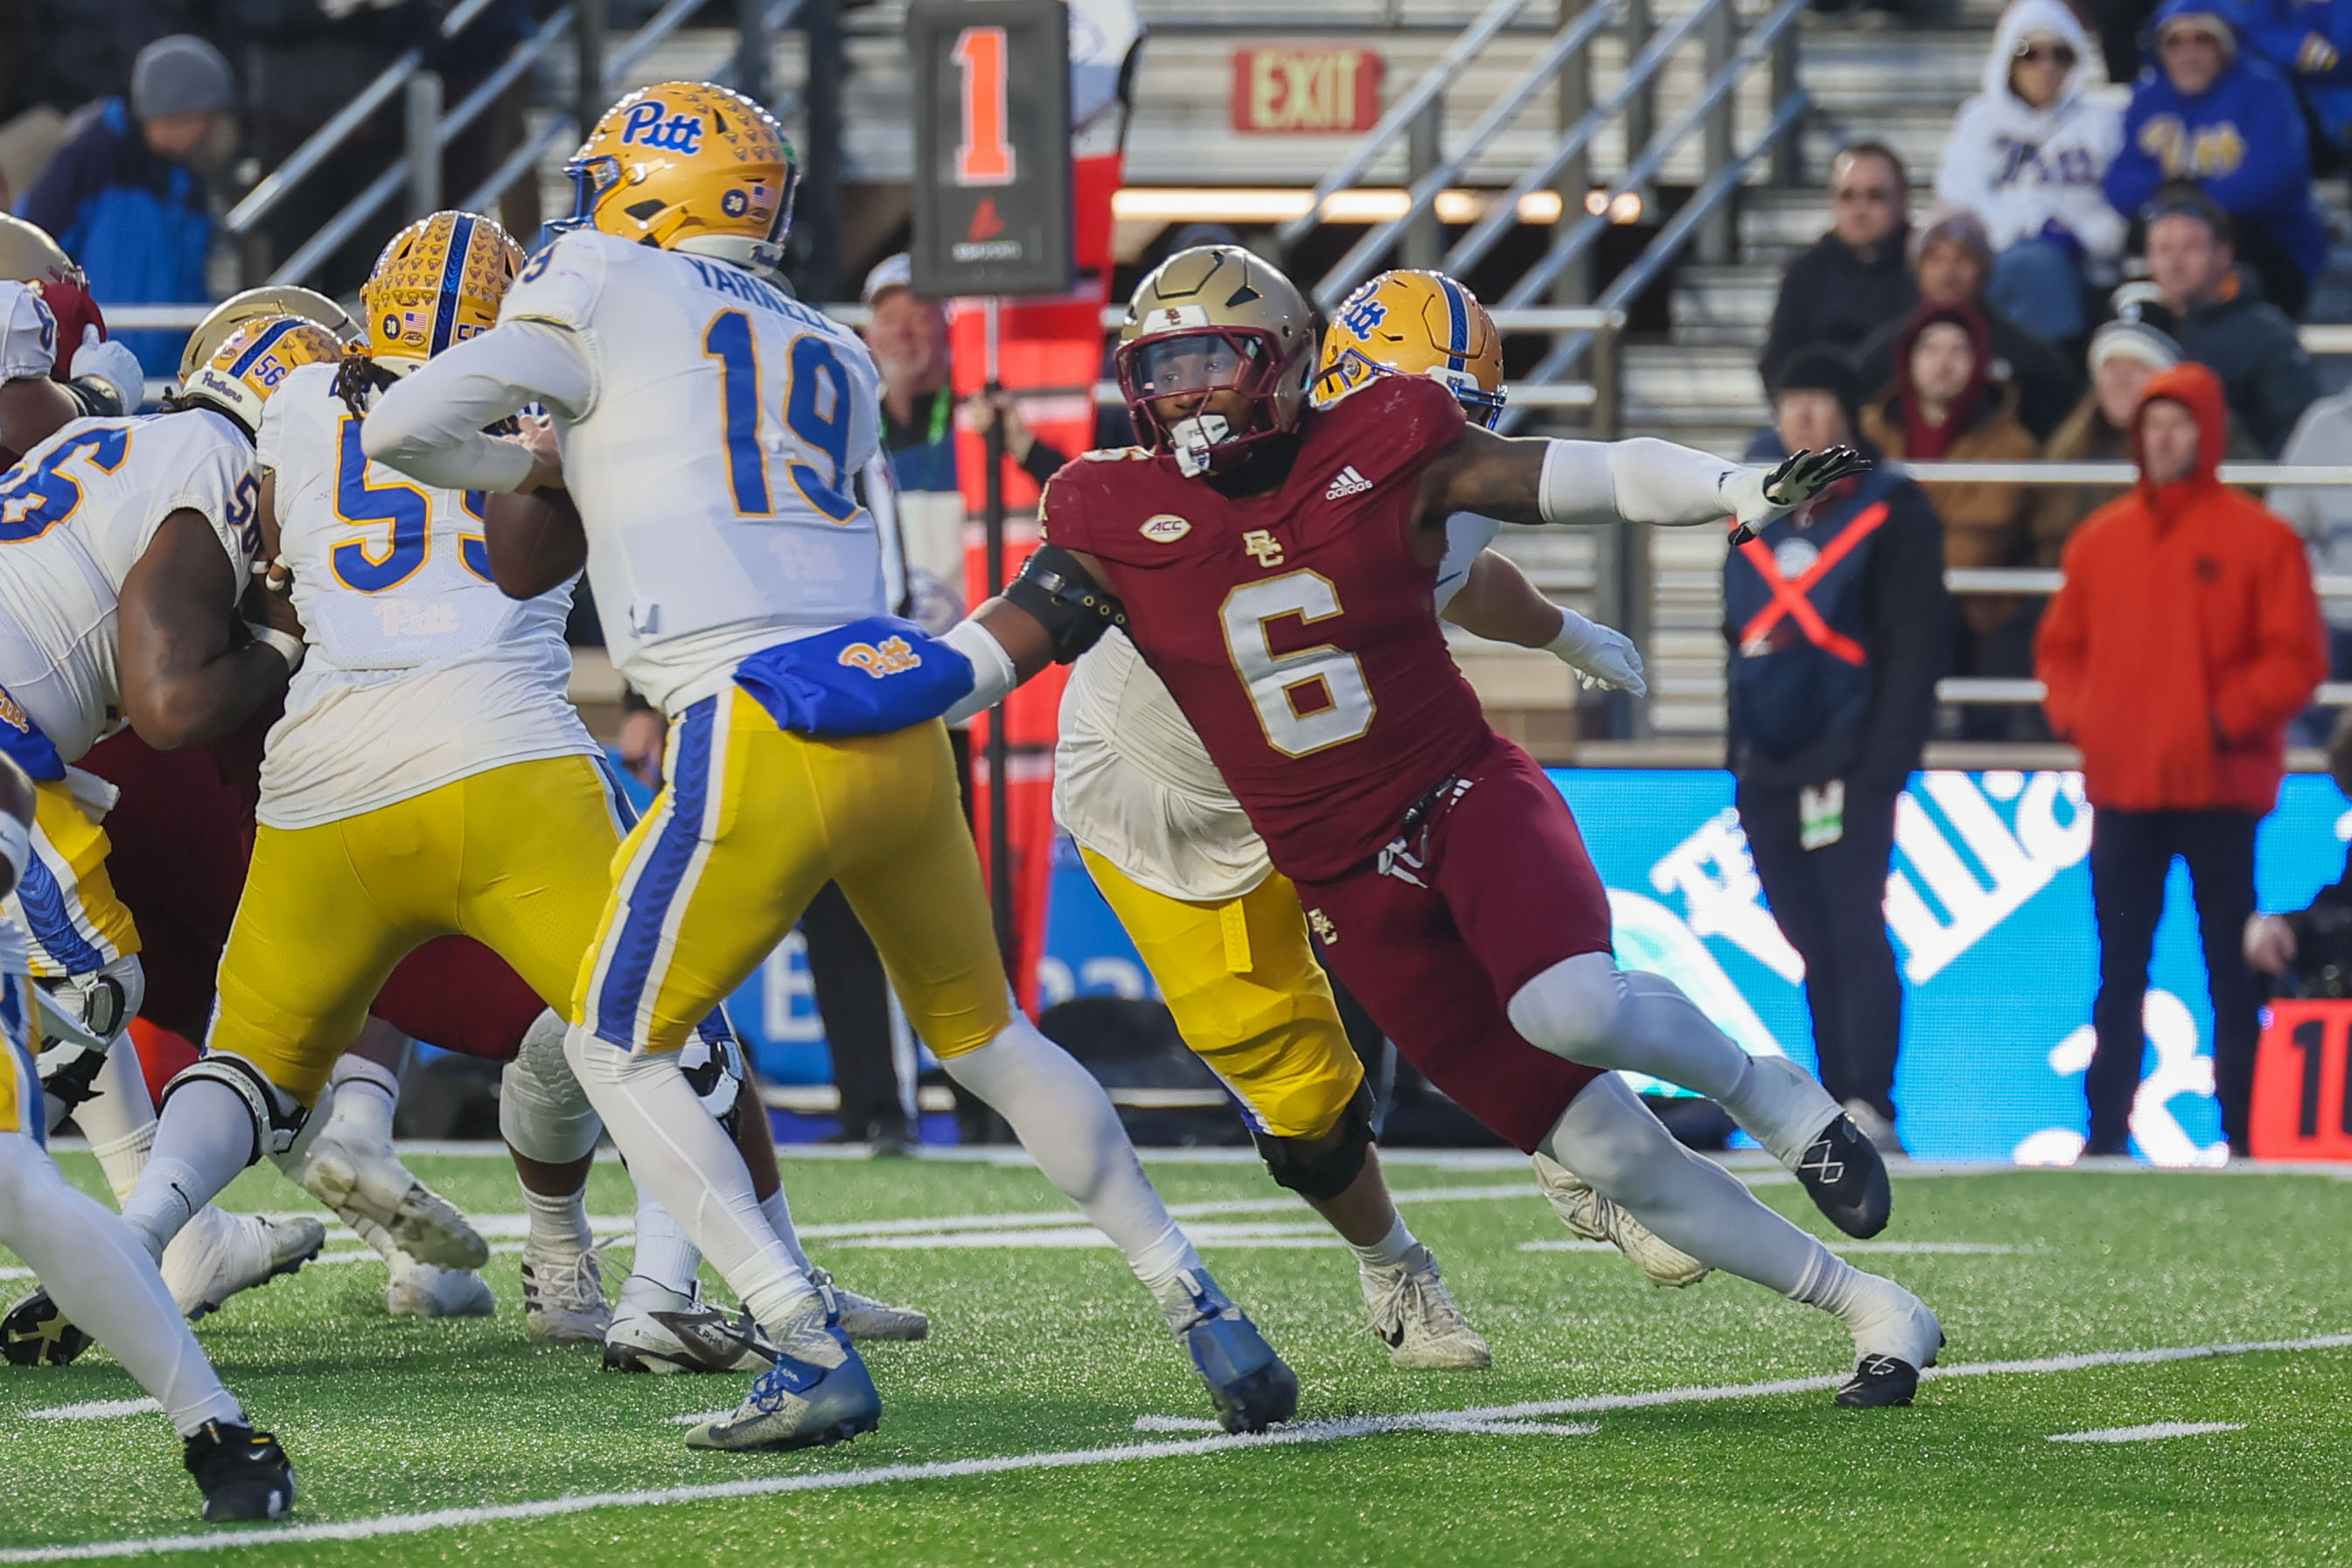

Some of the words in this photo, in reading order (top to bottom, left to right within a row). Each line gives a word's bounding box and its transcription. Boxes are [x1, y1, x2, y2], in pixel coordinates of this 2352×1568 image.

[952, 25, 1016, 187] 1
[1252, 51, 1362, 129] EXIT
[620, 99, 705, 157] Pitt
[386, 319, 397, 335] 38
[254, 353, 288, 387] 56
[701, 306, 862, 526] 19
[1325, 478, 1374, 500] adidas
[1148, 520, 1183, 533] ACC
[837, 634, 922, 679] Pitt
[1217, 567, 1378, 761] 6
